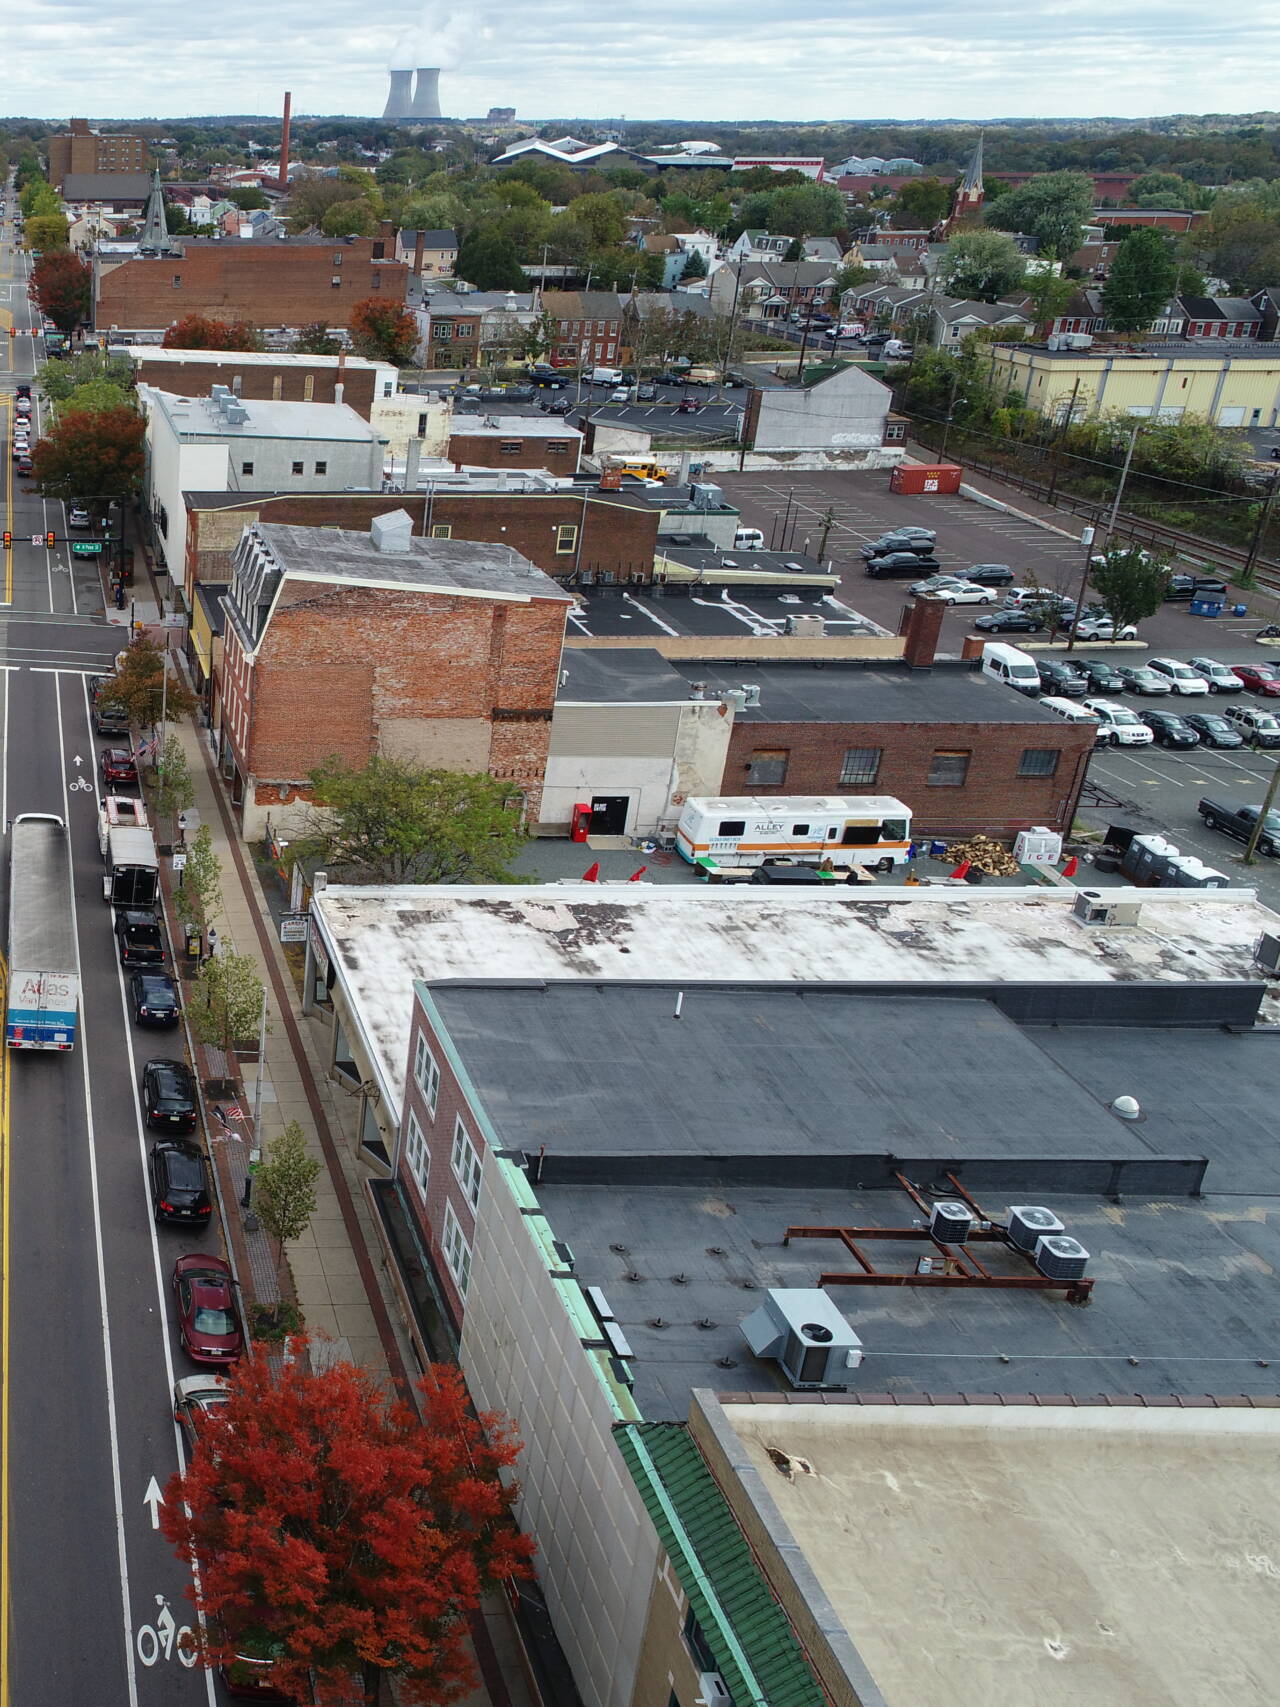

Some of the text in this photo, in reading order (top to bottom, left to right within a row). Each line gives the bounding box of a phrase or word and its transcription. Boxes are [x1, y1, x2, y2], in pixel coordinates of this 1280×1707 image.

[754, 823, 784, 831] ALLEY
[1027, 853, 1055, 861] ICE
[21, 978, 69, 996] Atlas
